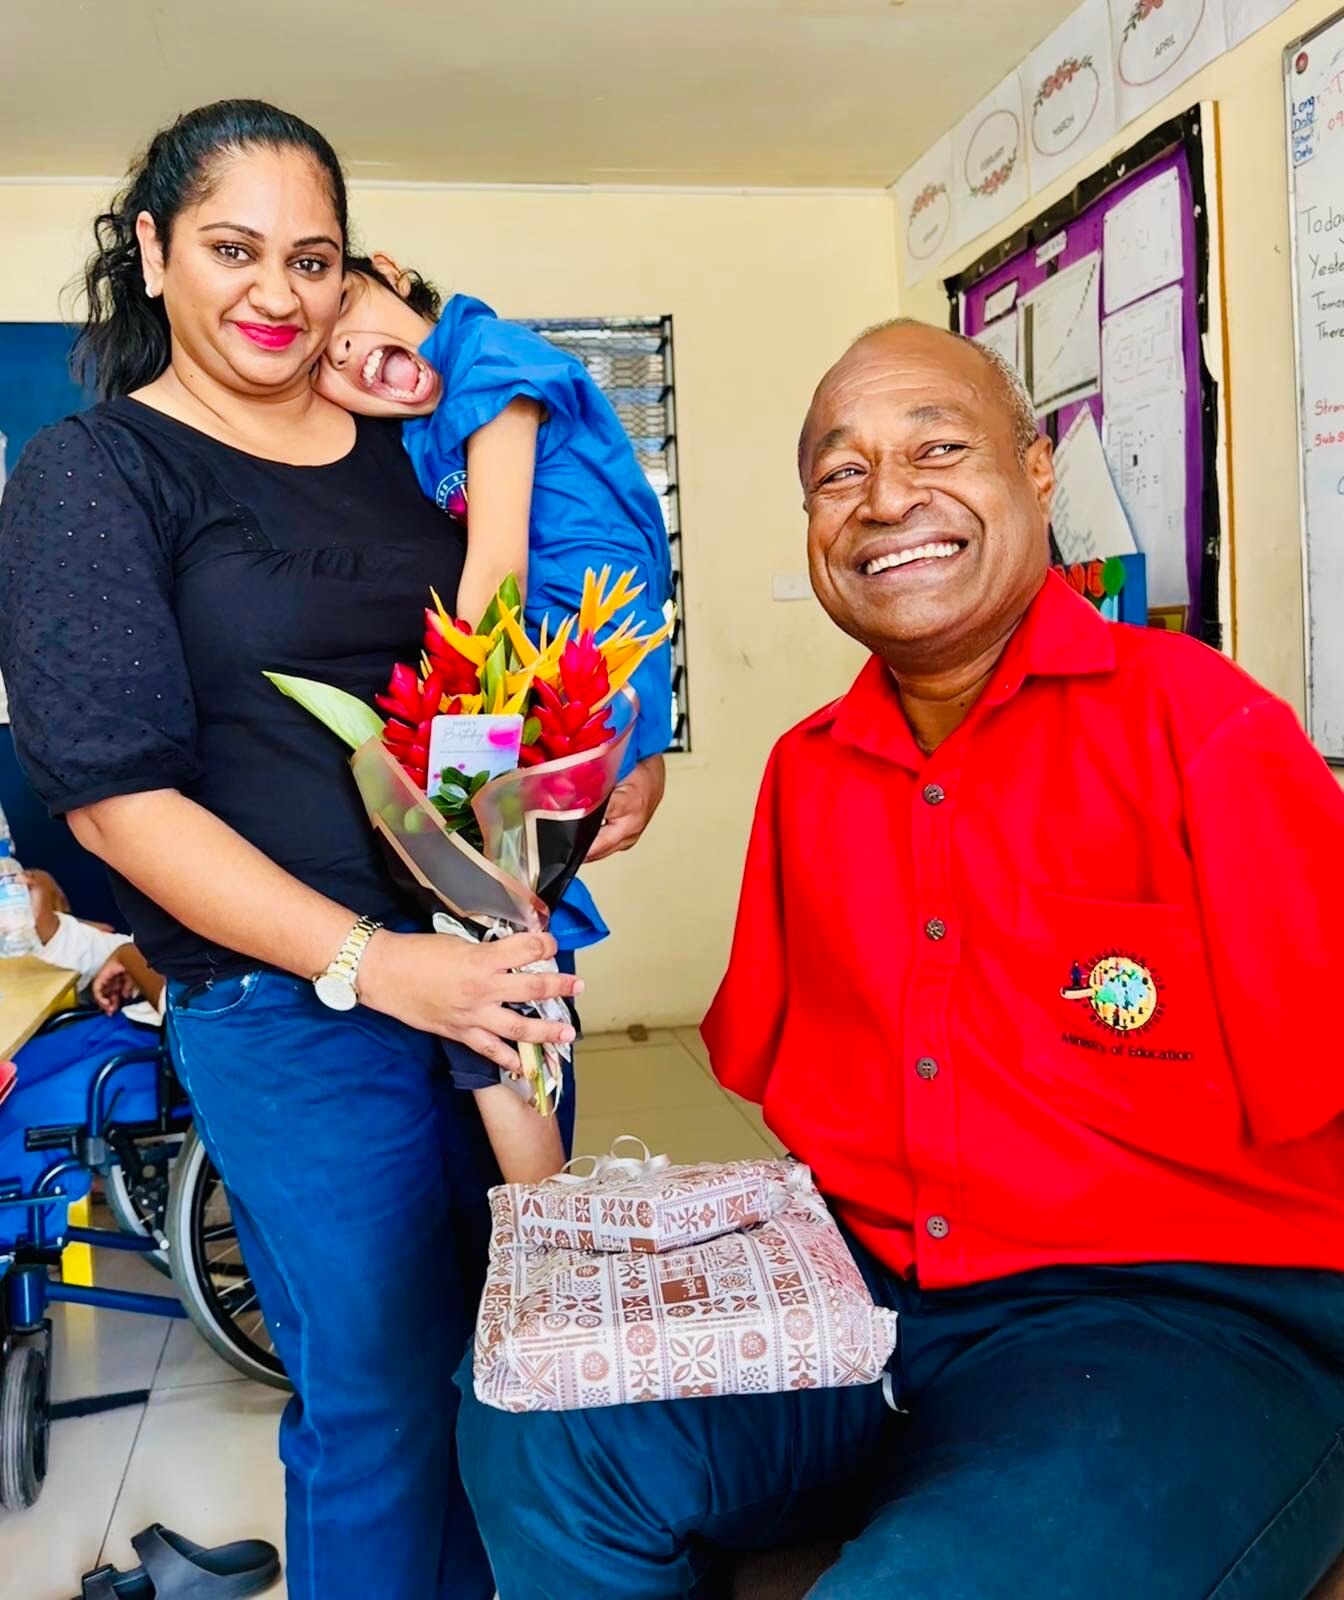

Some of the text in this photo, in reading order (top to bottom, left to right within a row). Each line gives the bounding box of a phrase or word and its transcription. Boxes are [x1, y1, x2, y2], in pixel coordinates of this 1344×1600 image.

[1061, 1032, 1194, 1062] Ministry of Education
